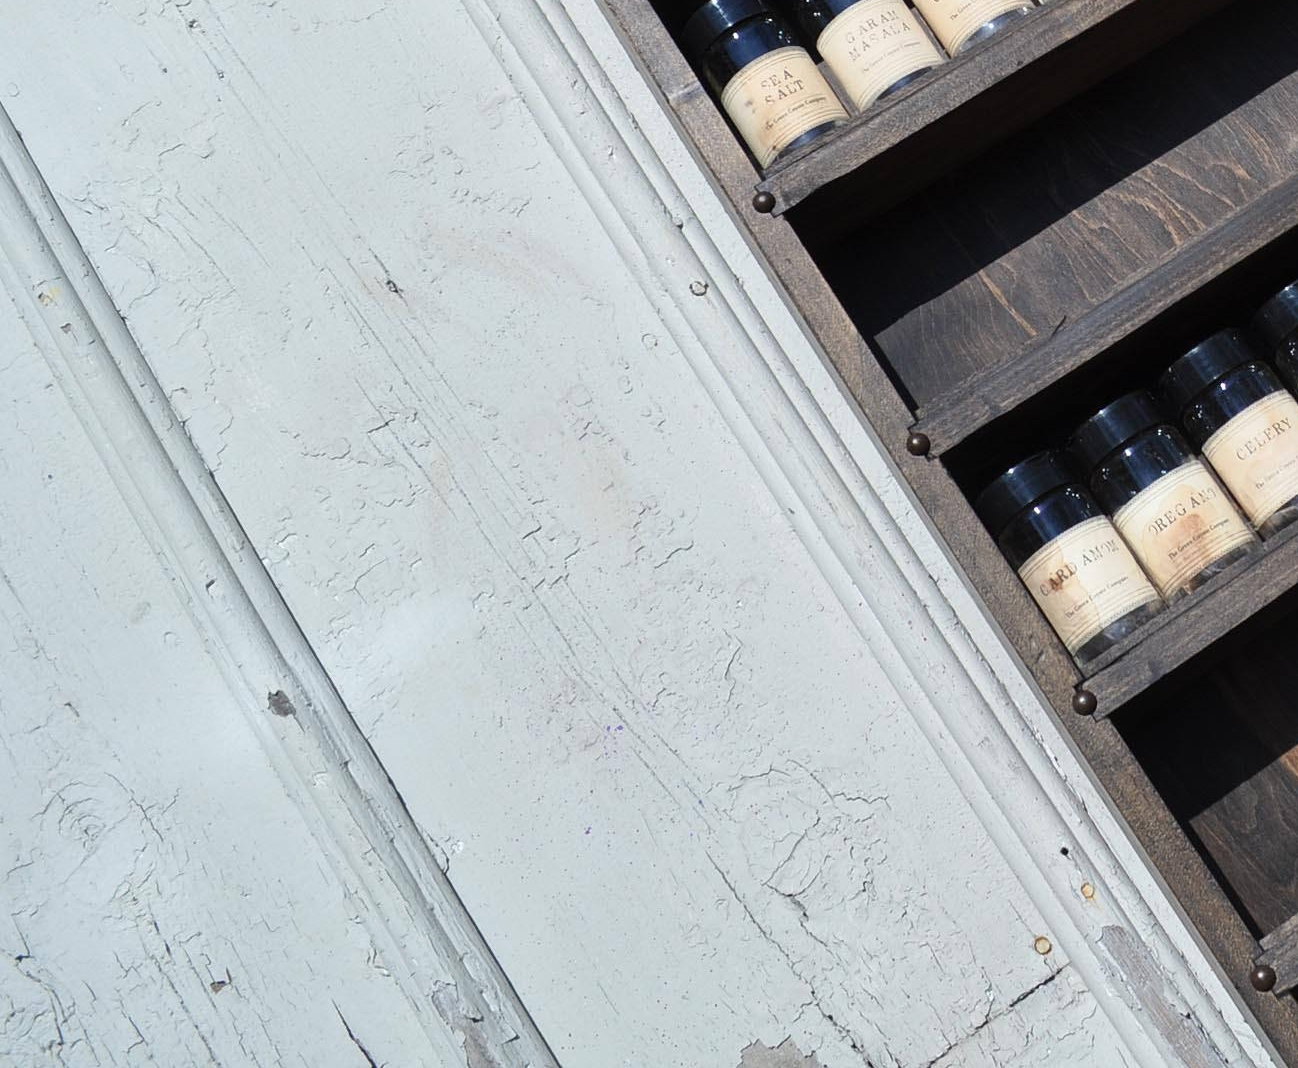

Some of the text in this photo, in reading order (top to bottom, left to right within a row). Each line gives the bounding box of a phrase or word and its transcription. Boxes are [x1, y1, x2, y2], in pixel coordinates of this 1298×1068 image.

[845, 9, 899, 45] GARAM
[848, 21, 912, 62] MASALA
[759, 66, 794, 91] SEA
[764, 79, 805, 107] SALT
[1236, 416, 1293, 463] CELERY
[1148, 485, 1218, 536] OREGANO
[1039, 537, 1120, 597] CARDAMOM
